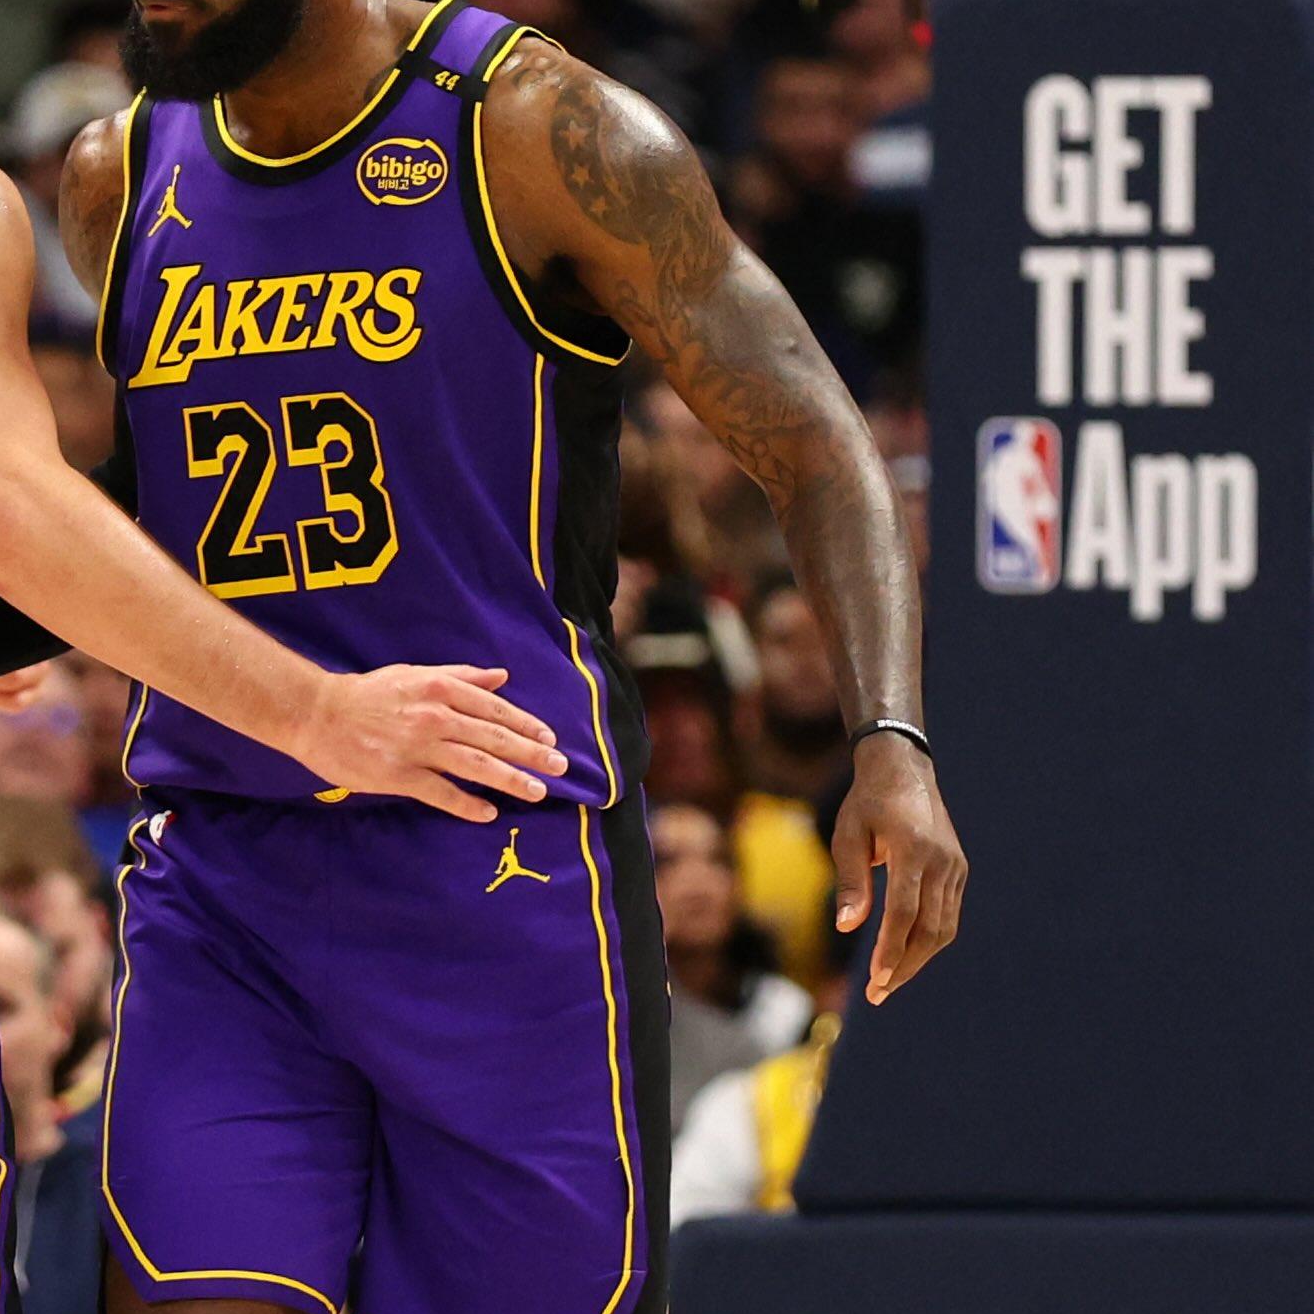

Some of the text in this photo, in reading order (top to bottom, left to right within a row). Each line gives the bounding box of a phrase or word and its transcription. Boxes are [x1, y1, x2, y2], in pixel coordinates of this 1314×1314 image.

[366, 155, 443, 186] bibigo
[1023, 74, 1213, 237] GET
[128, 265, 423, 389] LAKERS
[1019, 246, 1215, 407] THE
[182, 391, 399, 600] 23
[1065, 420, 1258, 622] App
